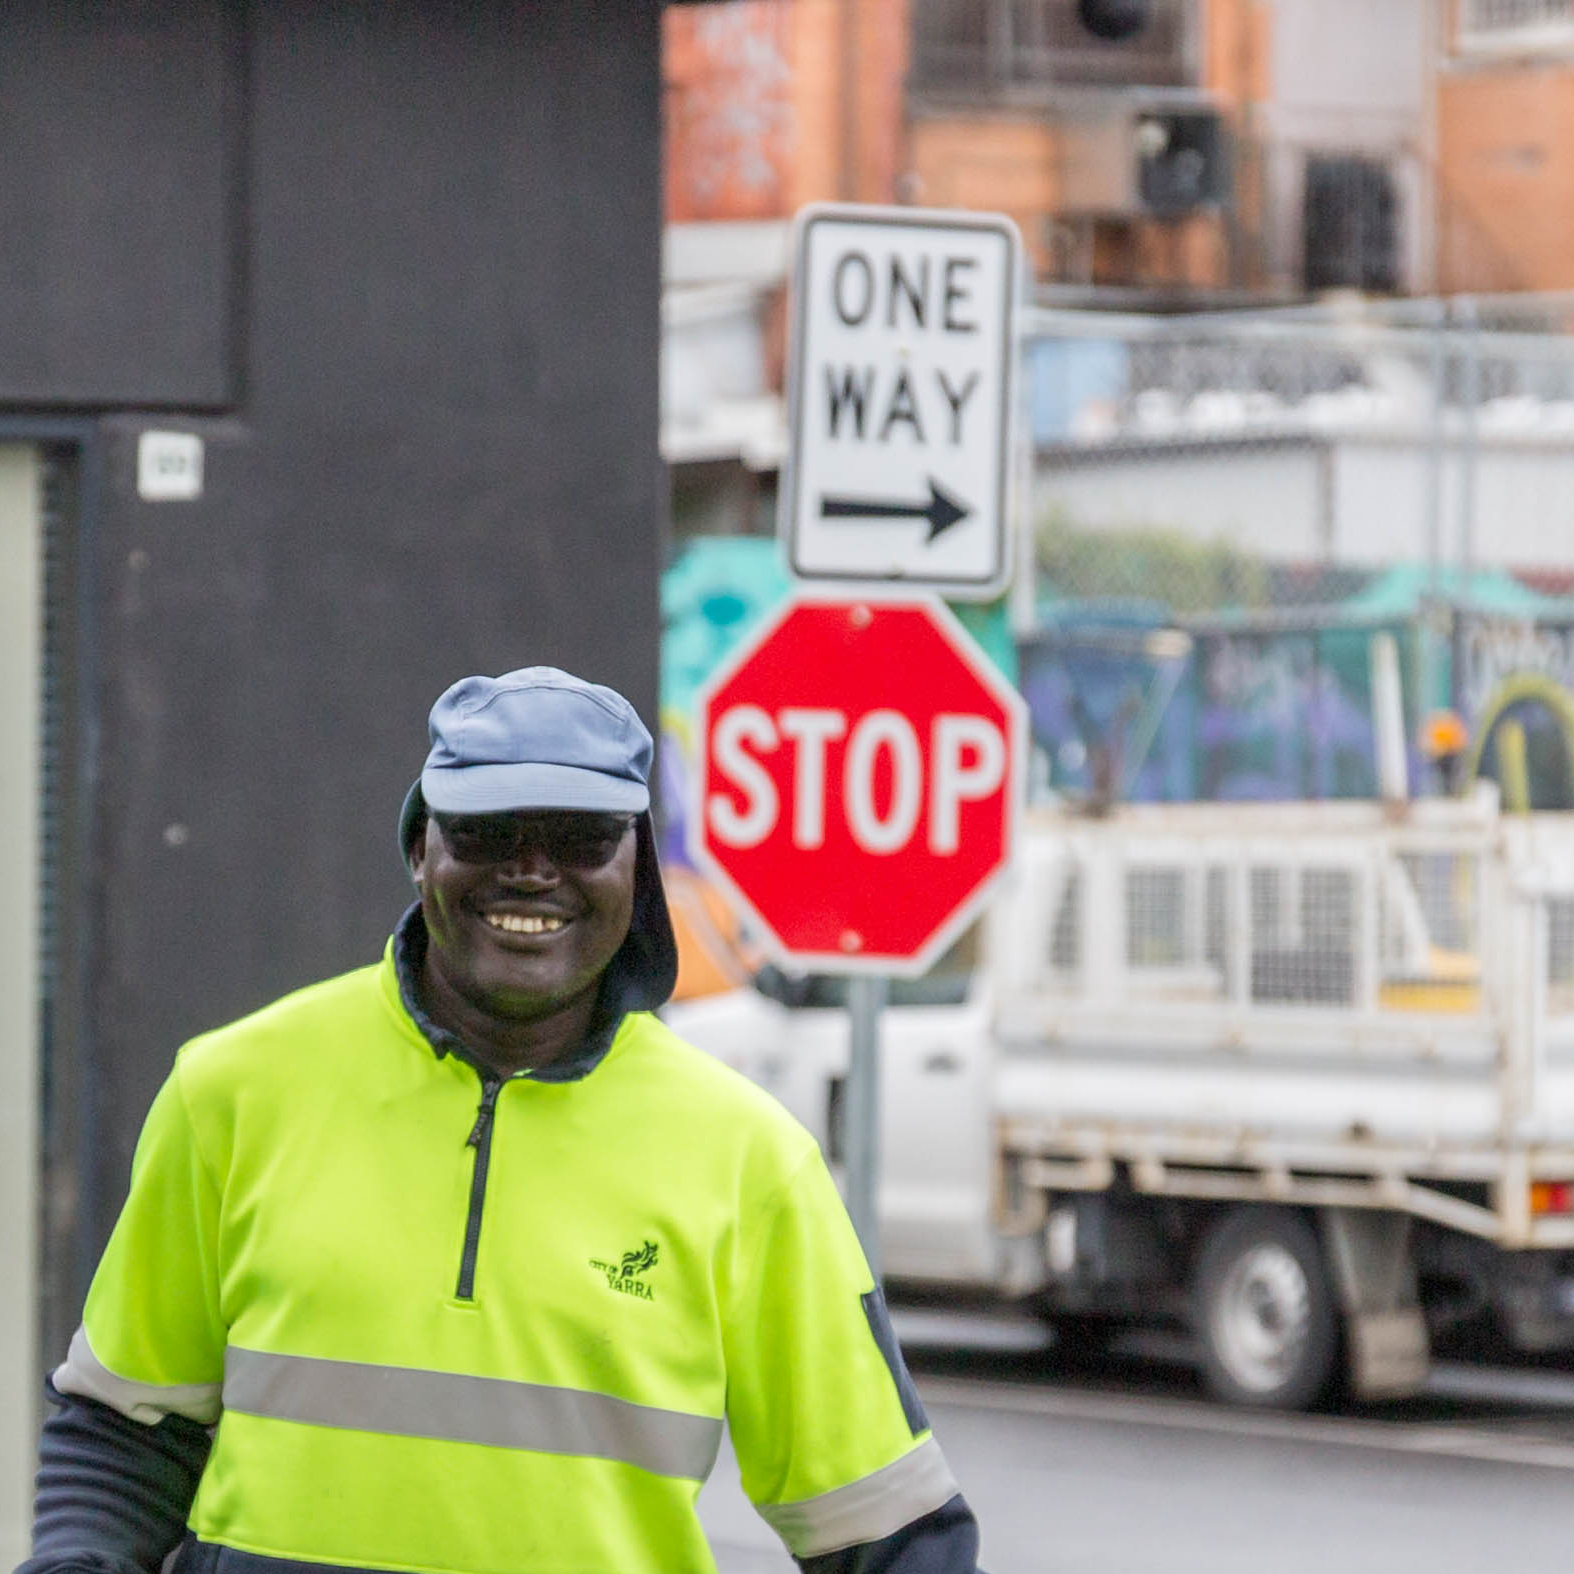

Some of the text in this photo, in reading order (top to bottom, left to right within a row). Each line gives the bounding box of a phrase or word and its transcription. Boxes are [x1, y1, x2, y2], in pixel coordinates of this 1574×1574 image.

[831, 250, 981, 333] ONE
[825, 364, 981, 447] WAY
[707, 703, 1007, 857] STOP
